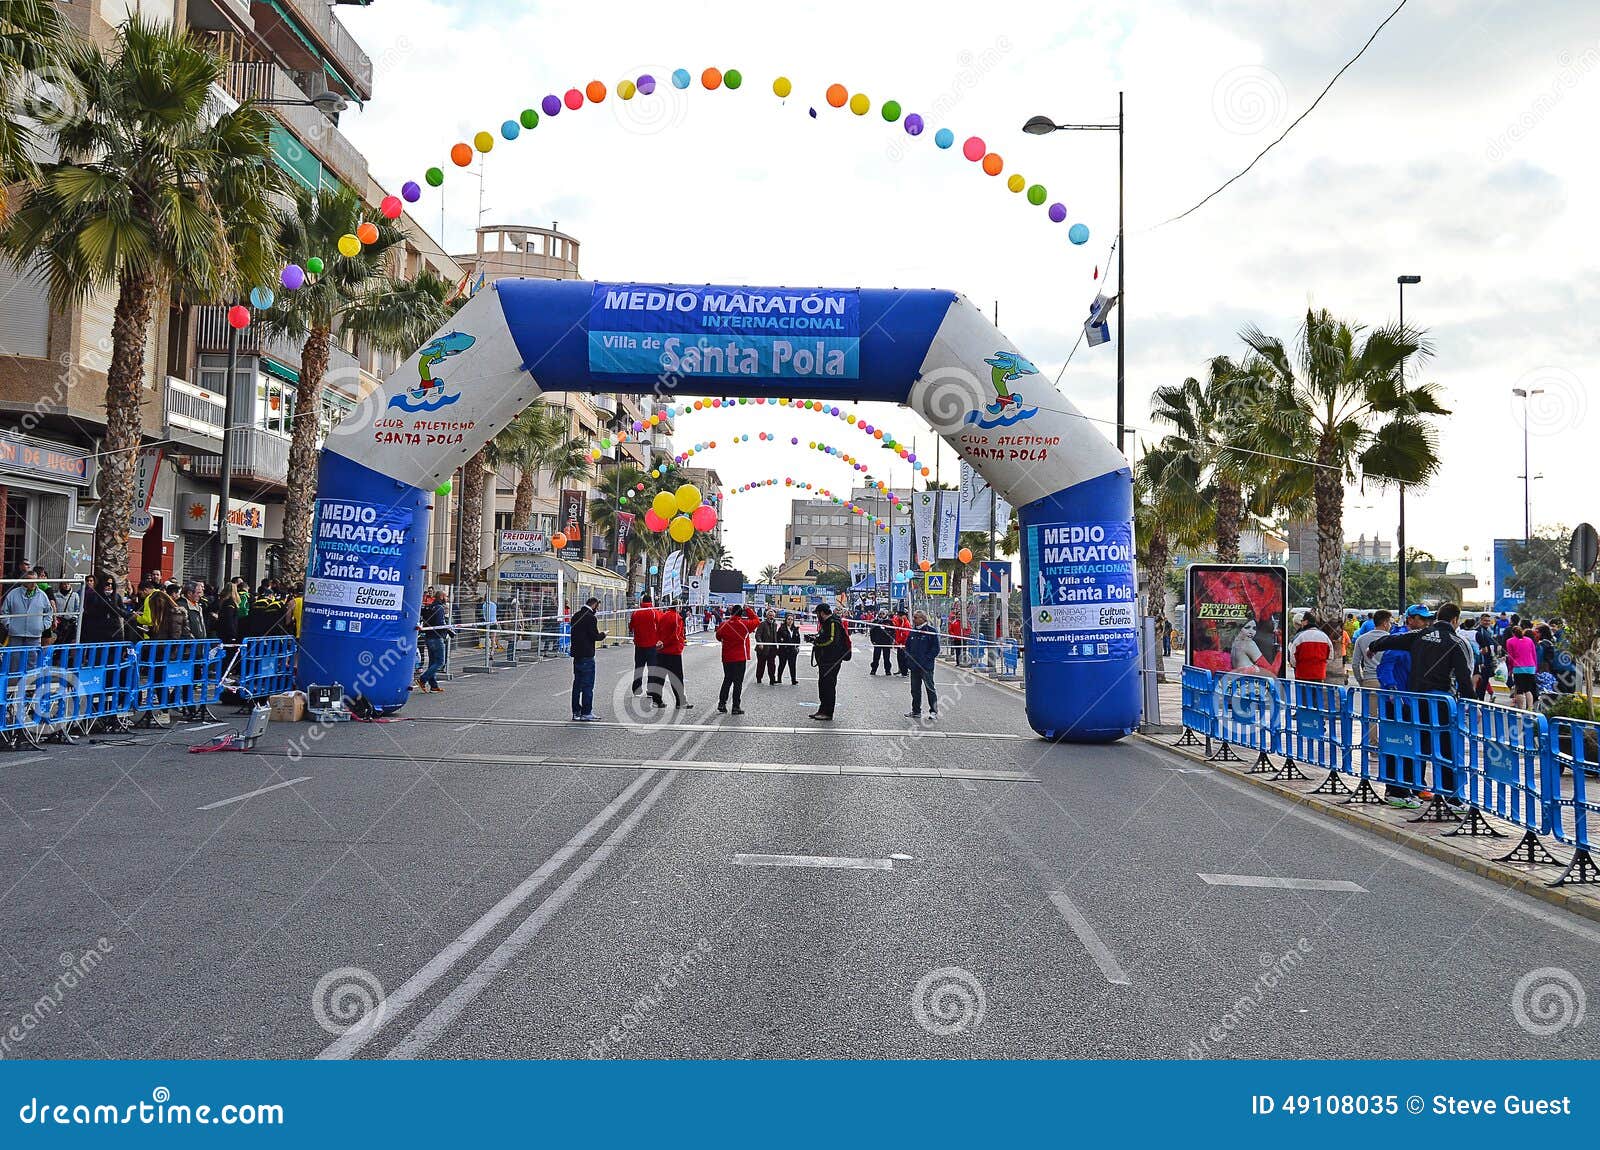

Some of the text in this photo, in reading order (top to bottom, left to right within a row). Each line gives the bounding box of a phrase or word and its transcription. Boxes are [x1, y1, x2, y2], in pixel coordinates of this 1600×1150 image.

[604, 292, 845, 315] MEDIO MARATÓN
[702, 315, 844, 330] INTERNACIONAL
[602, 335, 845, 376] Villa de Santa Pola
[374, 419, 476, 431] CLUB ATLETISMO
[374, 431, 464, 446] SANTA POLA
[960, 435, 1060, 446] CLUB ATLETISMO
[23, 447, 40, 464] DE
[47, 452, 85, 474] JUEGO
[964, 446, 1048, 461] SANTA POLA
[137, 458, 146, 509] JUEGO
[321, 504, 377, 524] MEDIO
[319, 522, 405, 545] MARATÓN
[502, 532, 543, 541] FREIDURIA
[1044, 526, 1105, 545] MEDIO
[319, 540, 402, 556] INTERNACIONAL
[1044, 541, 1129, 564] MARATÓN
[325, 552, 359, 562] Villa de
[323, 561, 401, 582] Santa Pola
[1046, 563, 1129, 576] INTERNACIONAL
[1058, 576, 1096, 585] Villa de
[357, 586, 389, 597] Cultura
[1058, 584, 1131, 602] Santa Pola
[355, 595, 396, 607] Esfuerzo
[1200, 602, 1248, 610] BENIDORM
[304, 606, 398, 621] www.mitjasantapola.com
[1199, 608, 1247, 618] PALACE
[1098, 616, 1132, 626] Esfuerzo
[1035, 632, 1135, 643] www.mitjasantapola.com
